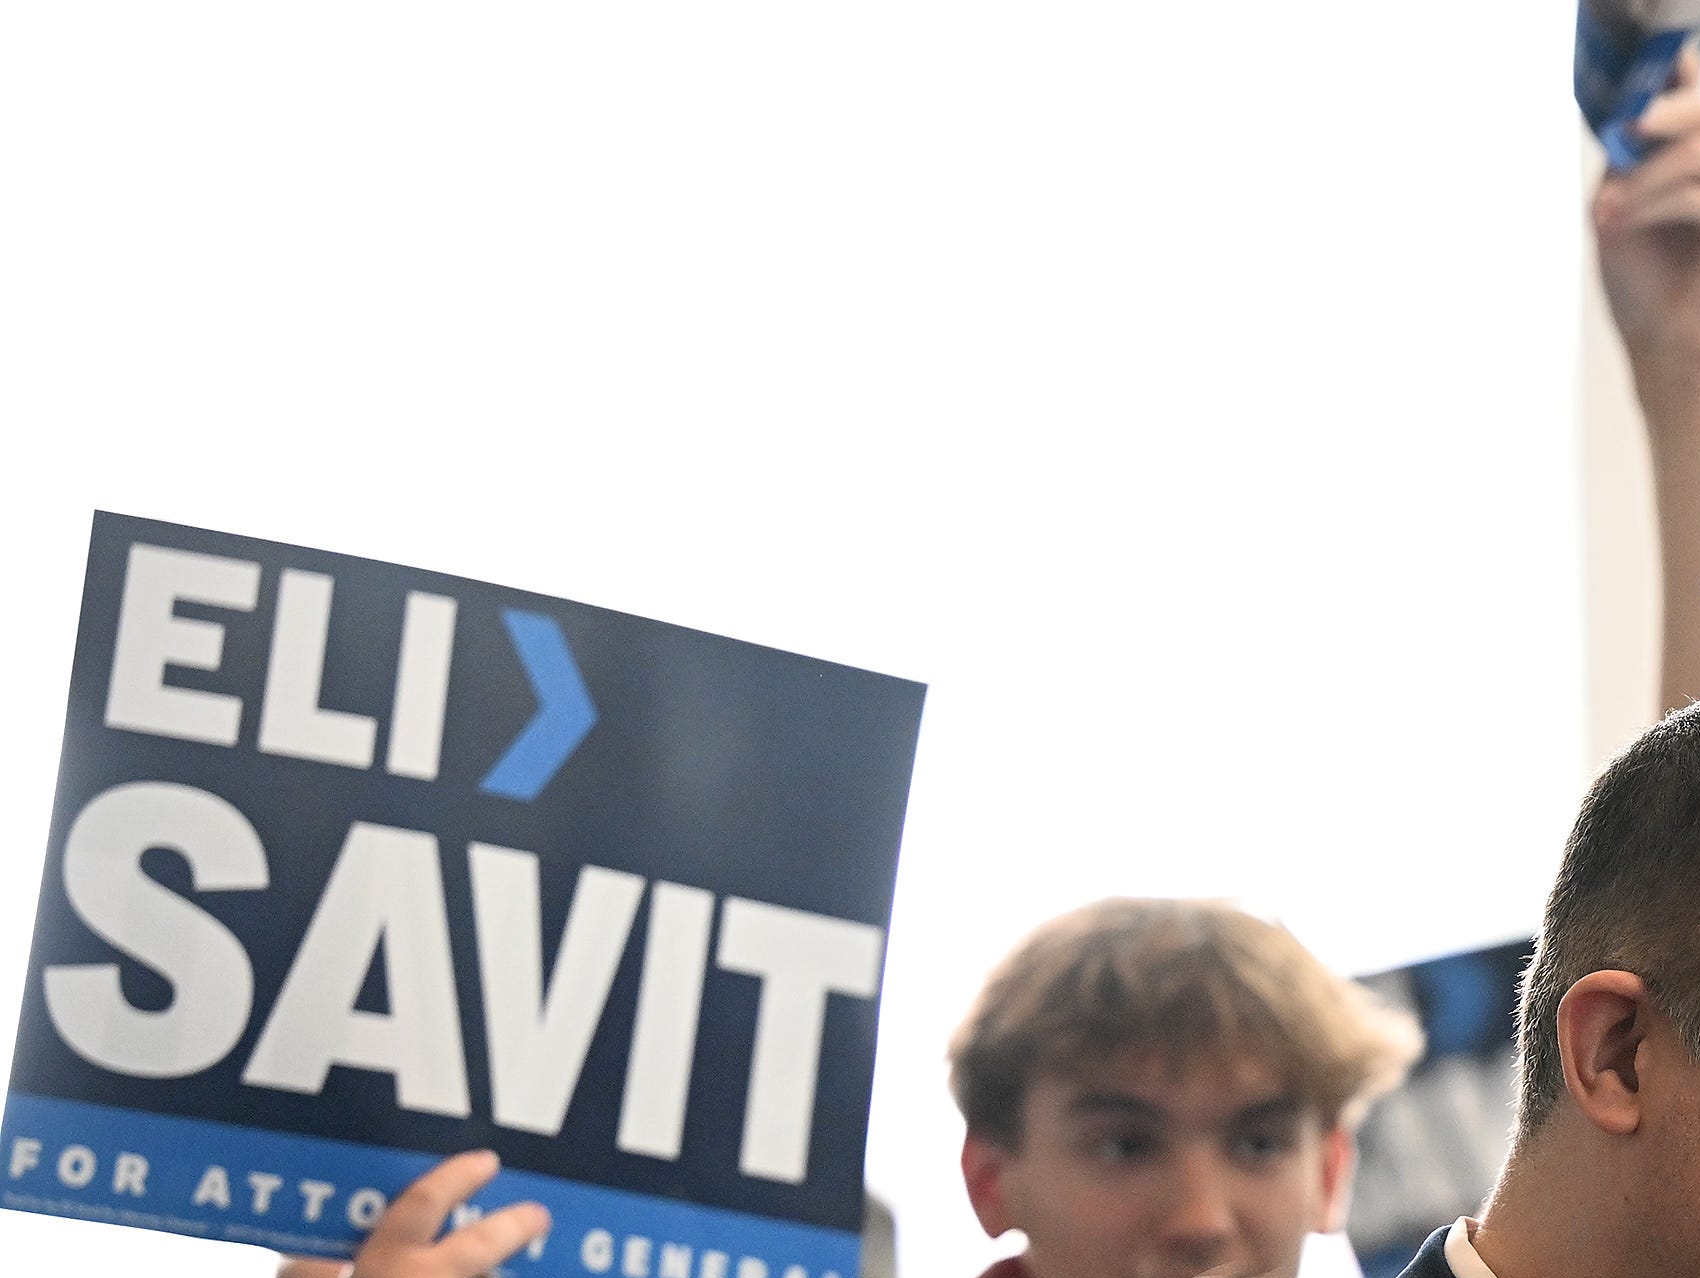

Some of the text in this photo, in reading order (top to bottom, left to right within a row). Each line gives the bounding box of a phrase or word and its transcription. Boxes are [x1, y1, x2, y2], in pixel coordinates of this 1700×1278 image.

[104, 542, 458, 782] ELI
[43, 779, 885, 1184] SAVIT
[9, 1136, 149, 1198] FOR
